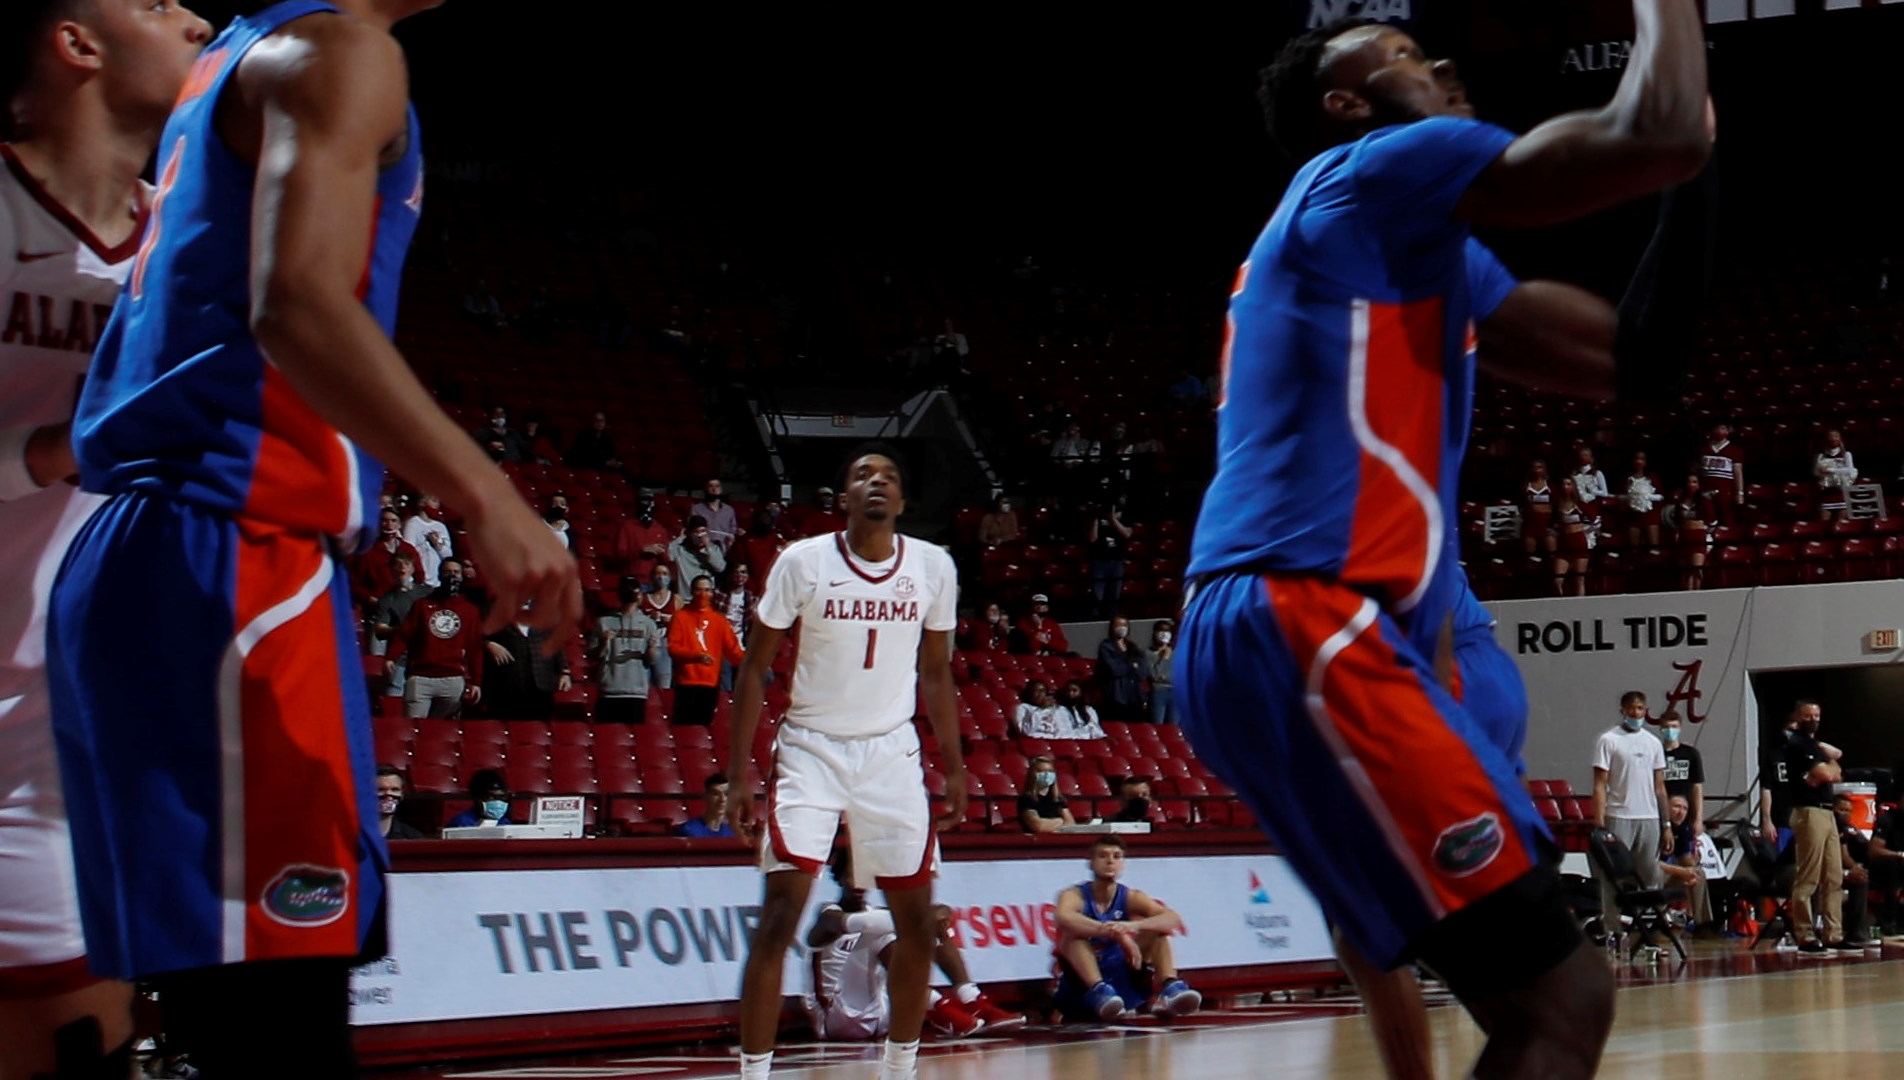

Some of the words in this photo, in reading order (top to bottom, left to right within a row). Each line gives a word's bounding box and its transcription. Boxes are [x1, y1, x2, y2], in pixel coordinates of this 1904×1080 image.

[823, 598, 920, 622] ALABAMA
[863, 628, 878, 670] 1
[1518, 617, 1615, 655] ROLL
[1623, 613, 1708, 650] TIDE
[476, 910, 601, 974] THE
